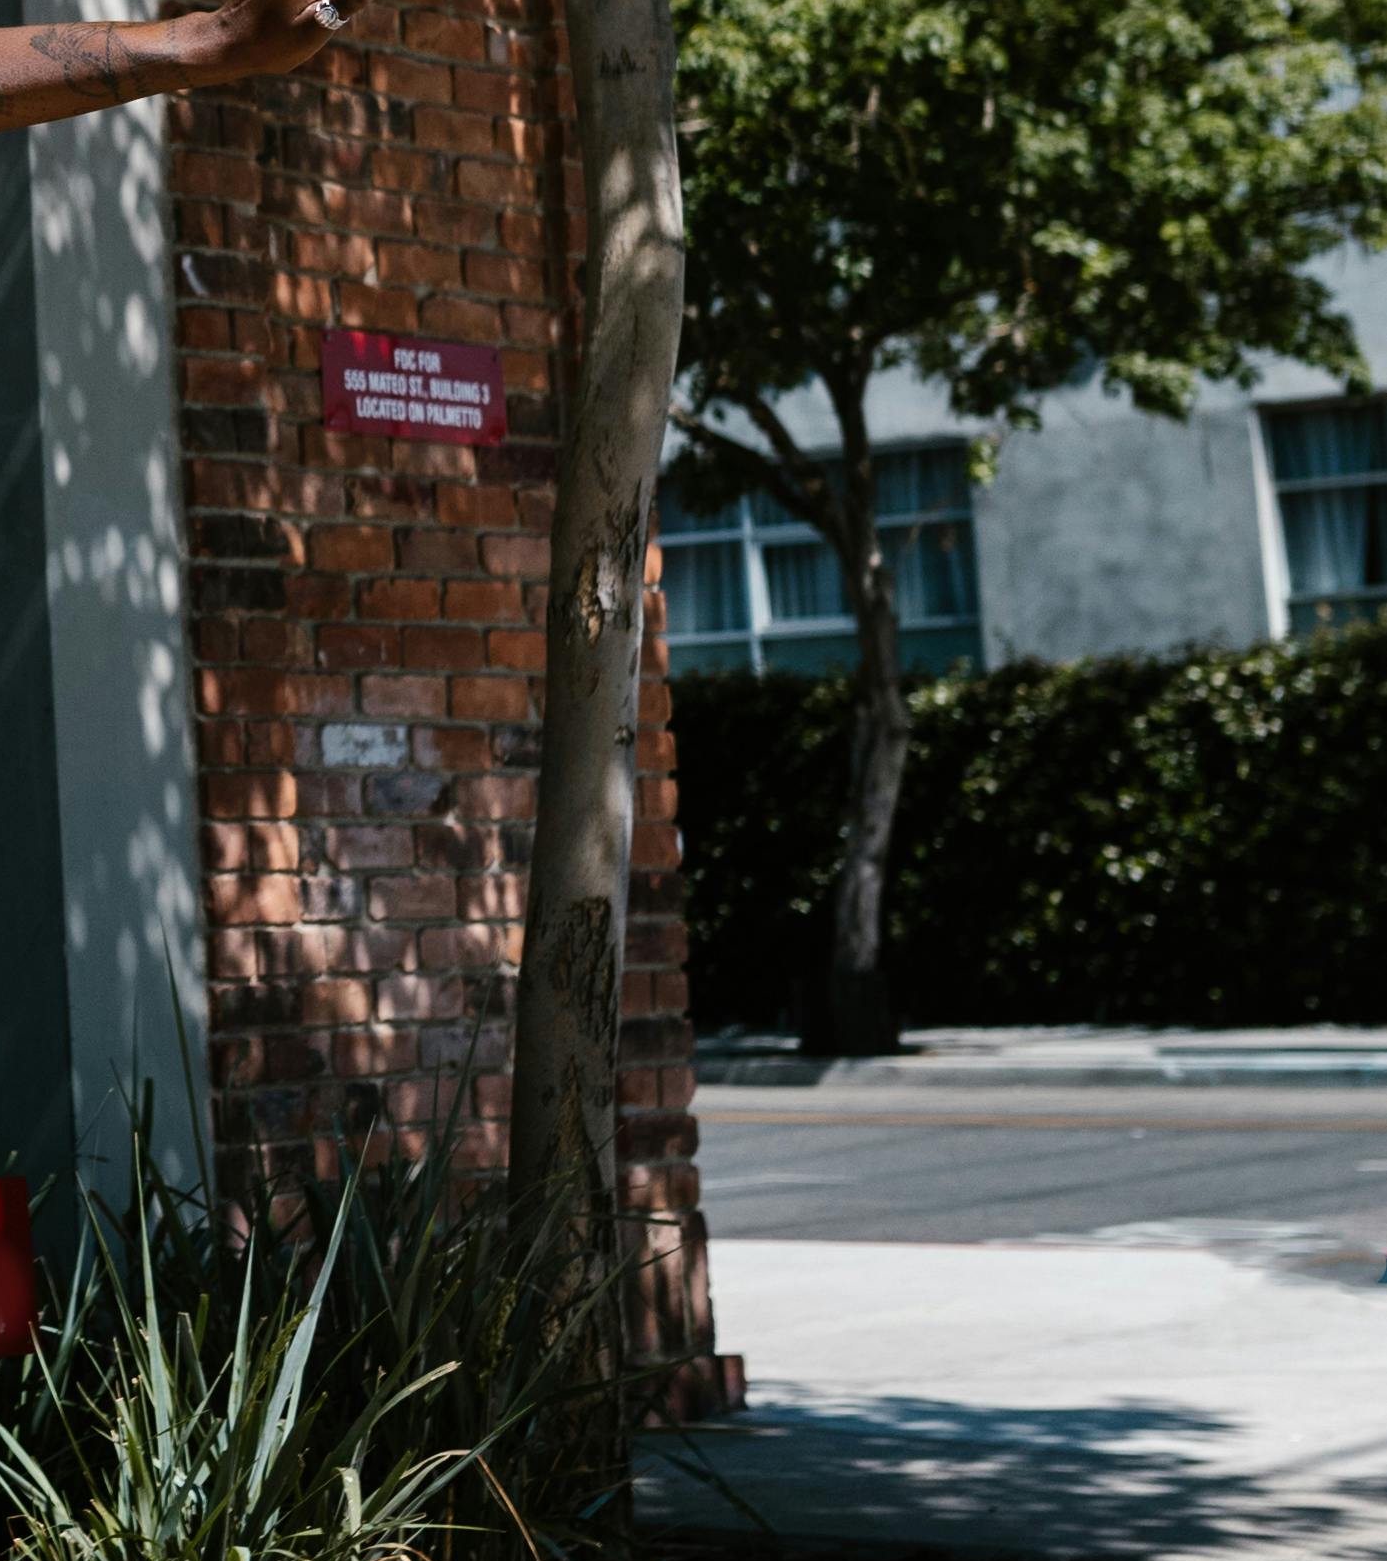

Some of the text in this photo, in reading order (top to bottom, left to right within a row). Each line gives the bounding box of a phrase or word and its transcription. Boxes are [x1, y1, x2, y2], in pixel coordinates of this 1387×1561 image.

[393, 348, 441, 373] FDC FOR
[368, 370, 407, 395] MATEO
[429, 377, 481, 404] BUILDING
[355, 396, 483, 430] LOCATED ON PALMETTO
